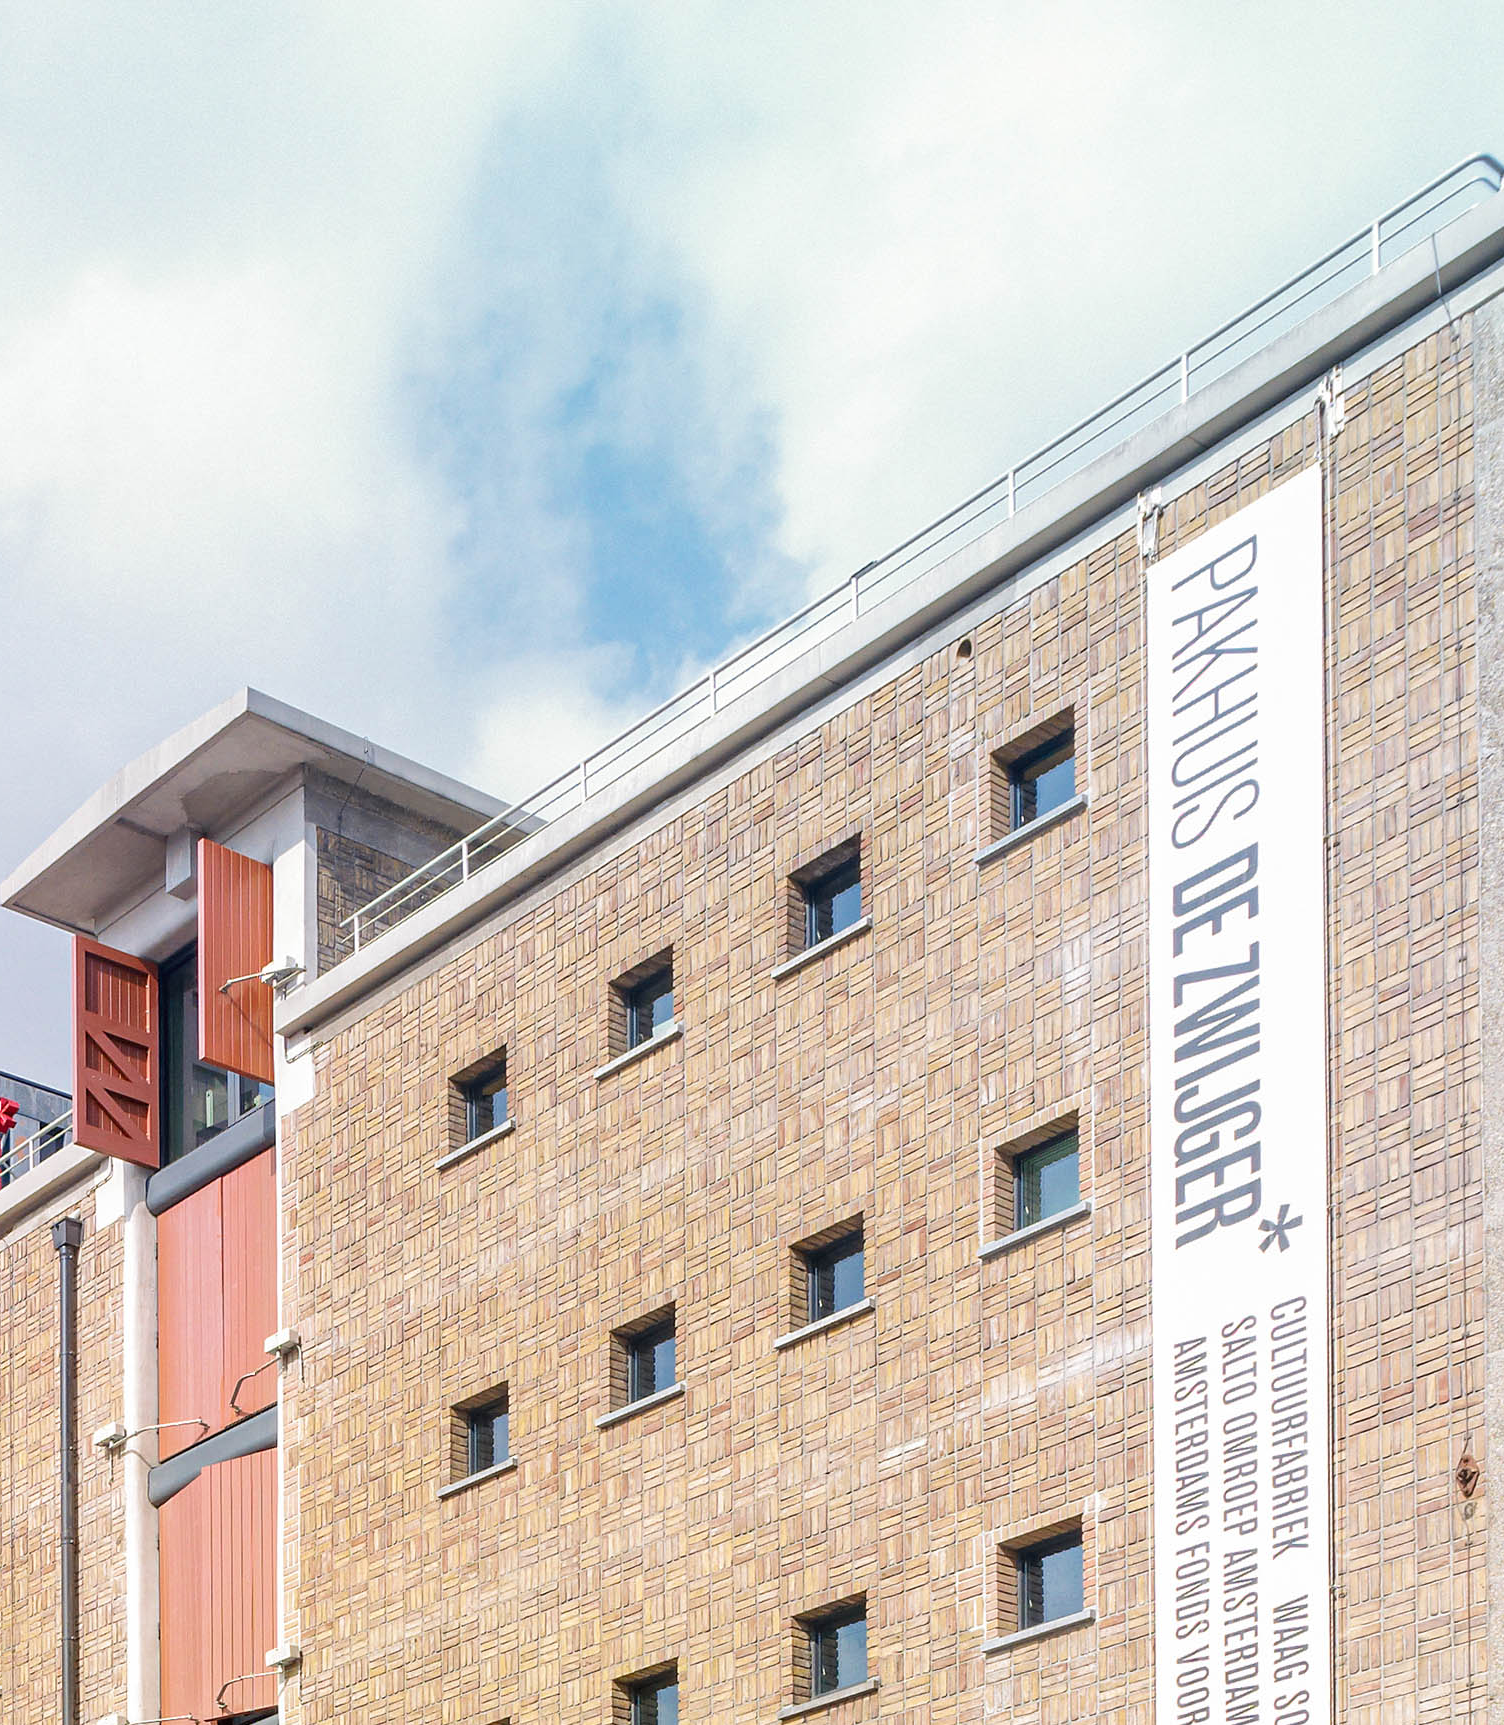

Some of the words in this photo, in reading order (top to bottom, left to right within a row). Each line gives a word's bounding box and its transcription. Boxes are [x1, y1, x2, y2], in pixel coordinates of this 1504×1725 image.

[1171, 533, 1260, 850] PAKHUIS
[1172, 841, 1259, 959] DE
[1221, 1314, 1257, 1405] SALTO
[1174, 1336, 1210, 1537] AMSTERDAMS
[1222, 1411, 1258, 1536] OMROEP
[1270, 1295, 1309, 1560] CULTUURFABRIEK
[1175, 1540, 1210, 1640] FONDS
[1273, 1594, 1309, 1684] WAAG
